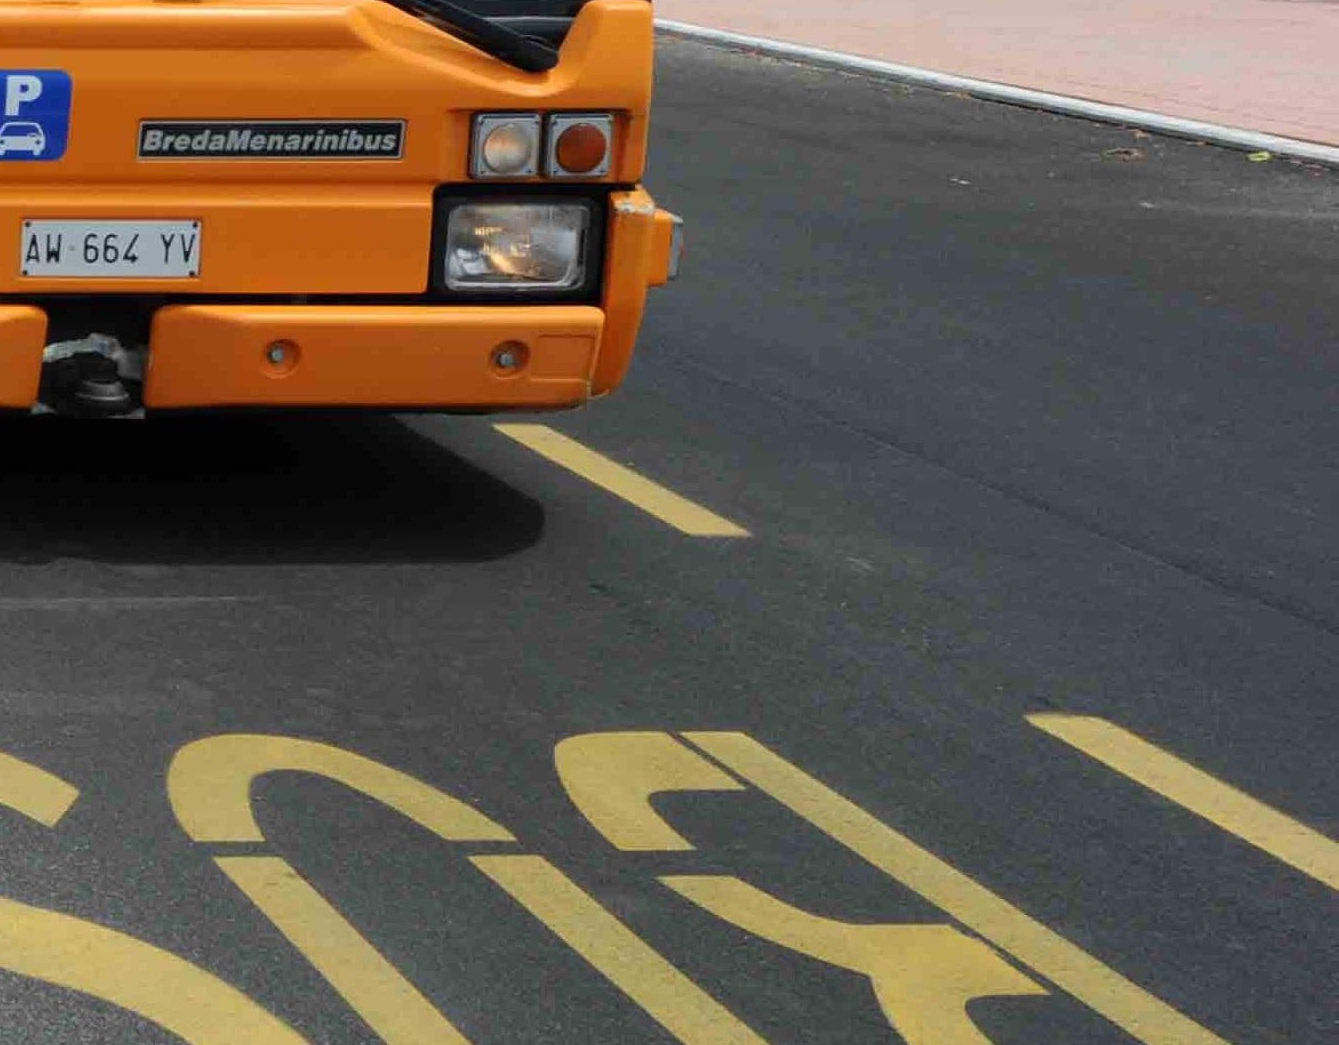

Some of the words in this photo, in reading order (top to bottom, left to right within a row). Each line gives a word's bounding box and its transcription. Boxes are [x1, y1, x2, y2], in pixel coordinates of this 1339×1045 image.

[5, 75, 42, 116] P
[142, 128, 398, 153] BredaMenarinibus
[25, 233, 62, 264] AW
[82, 233, 140, 264] 664
[160, 233, 196, 264] YV
